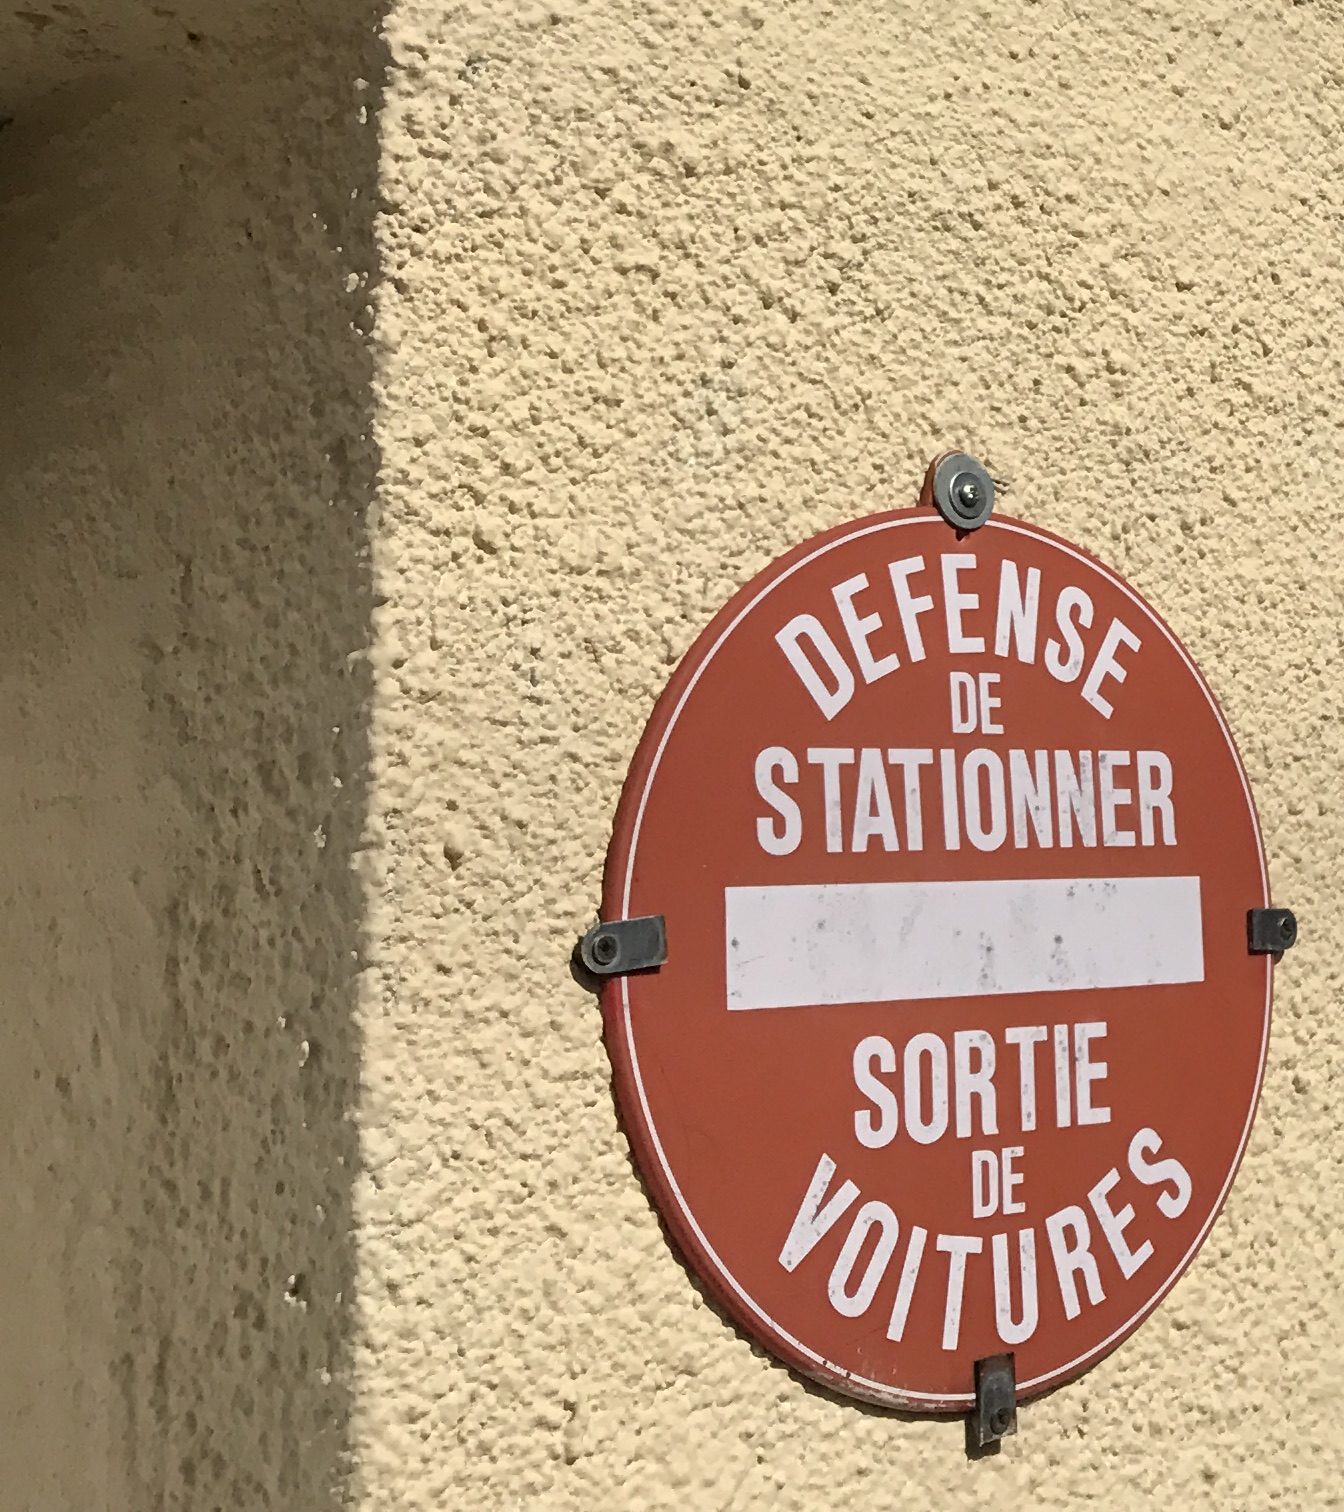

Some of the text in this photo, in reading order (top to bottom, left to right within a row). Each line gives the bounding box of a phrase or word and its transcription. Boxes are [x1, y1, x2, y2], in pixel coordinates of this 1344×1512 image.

[774, 553, 1142, 722] DEFENSE
[949, 671, 1005, 735] DE
[754, 746, 1178, 856] STATIONNER
[852, 1021, 1113, 1149] SORTIE
[778, 1126, 1194, 1351] VOITURES
[971, 1145, 1027, 1219] DE
